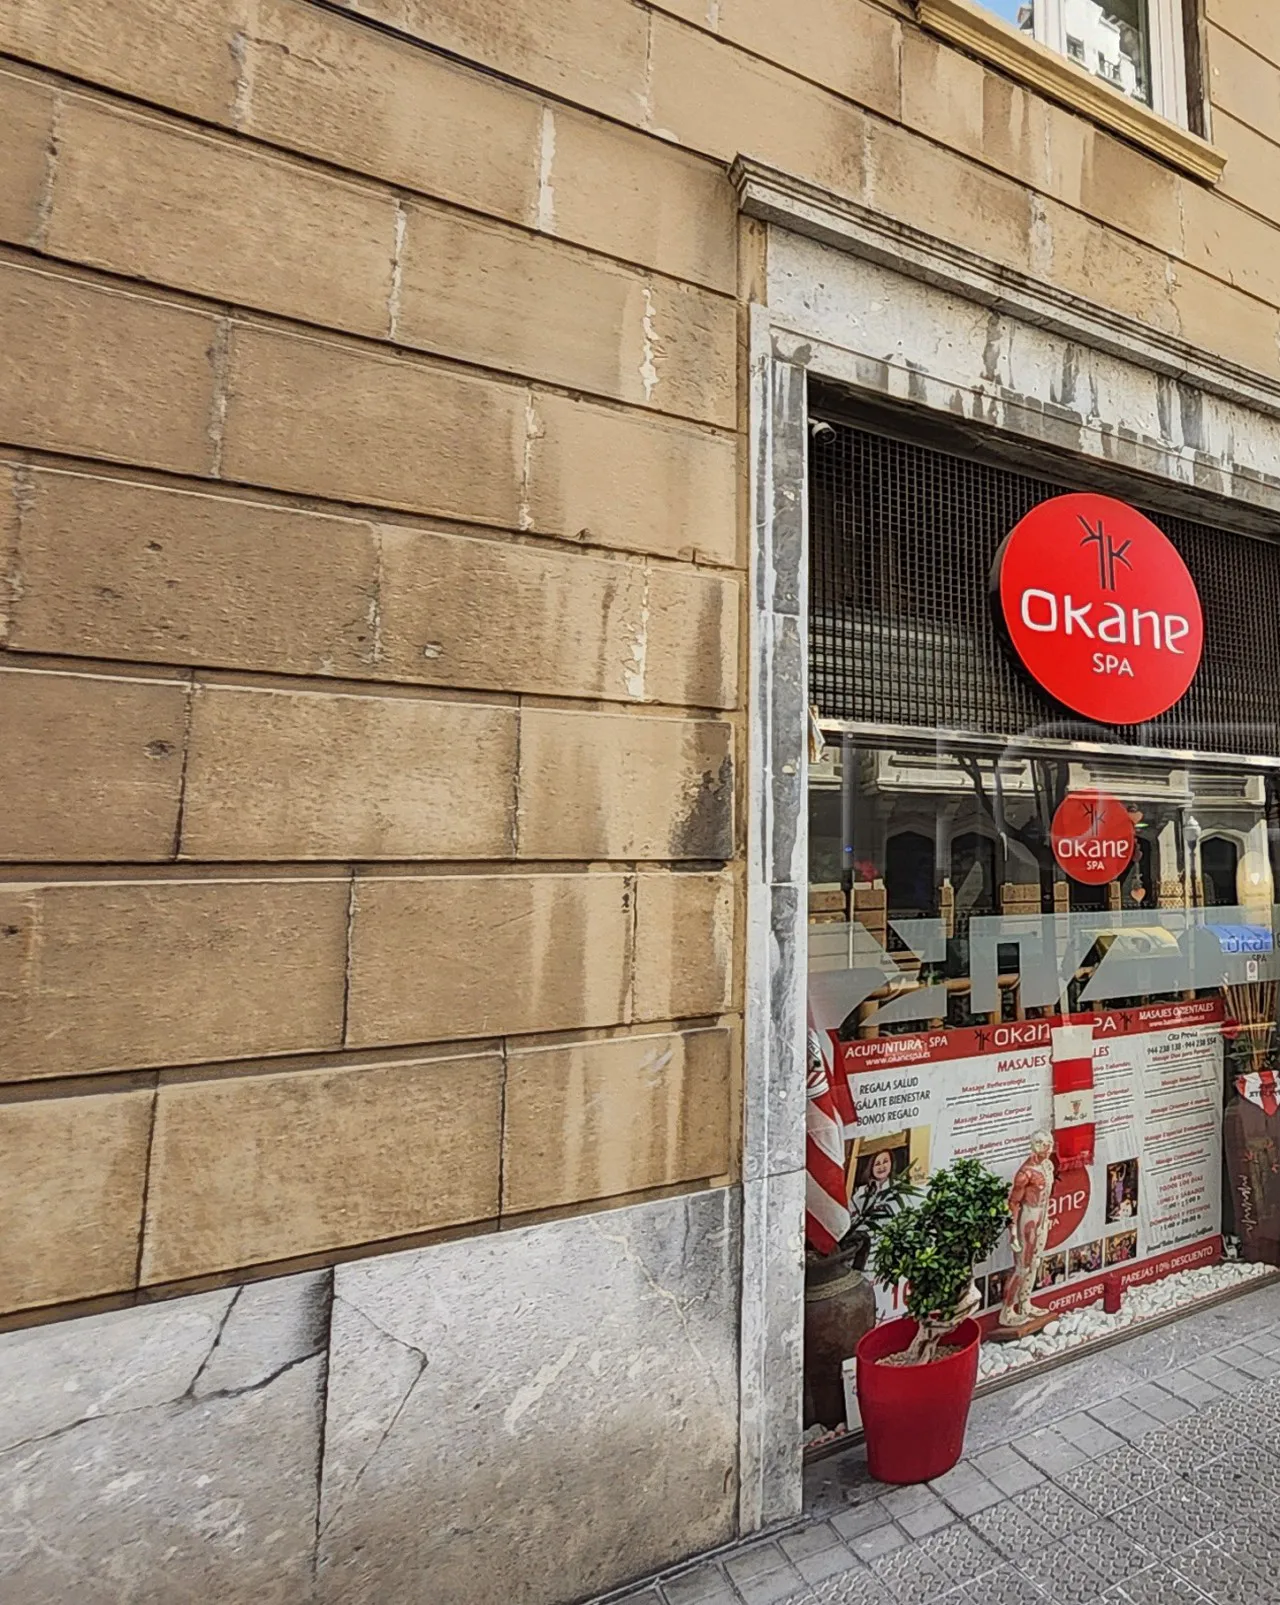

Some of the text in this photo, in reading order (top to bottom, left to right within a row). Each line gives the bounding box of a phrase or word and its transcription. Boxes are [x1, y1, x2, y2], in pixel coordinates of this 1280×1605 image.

[1020, 588, 1190, 654] Okane
[1091, 651, 1135, 678] SPA
[1057, 835, 1129, 859] Okane
[1086, 860, 1105, 872] SPA
[1251, 953, 1267, 962] SPA
[1139, 1008, 1172, 1020] MASAJES
[993, 1016, 1117, 1047] Okan PA
[845, 1035, 949, 1059] ACUPUNTURA SPA
[997, 1055, 1047, 1073] MASAJES
[860, 1077, 918, 1095] REGALA SALUD
[854, 1095, 888, 1112] GÁLATE
[889, 1090, 931, 1106] BIENESTAR
[856, 1106, 919, 1127] BONOS REGALO
[1047, 1190, 1086, 1217] ane
[1048, 1291, 1083, 1311] OFERTA
[1083, 1283, 1105, 1301] ESPE
[1120, 1266, 1155, 1286] PAREJAS
[1170, 1245, 1214, 1271] DESCUENTO
